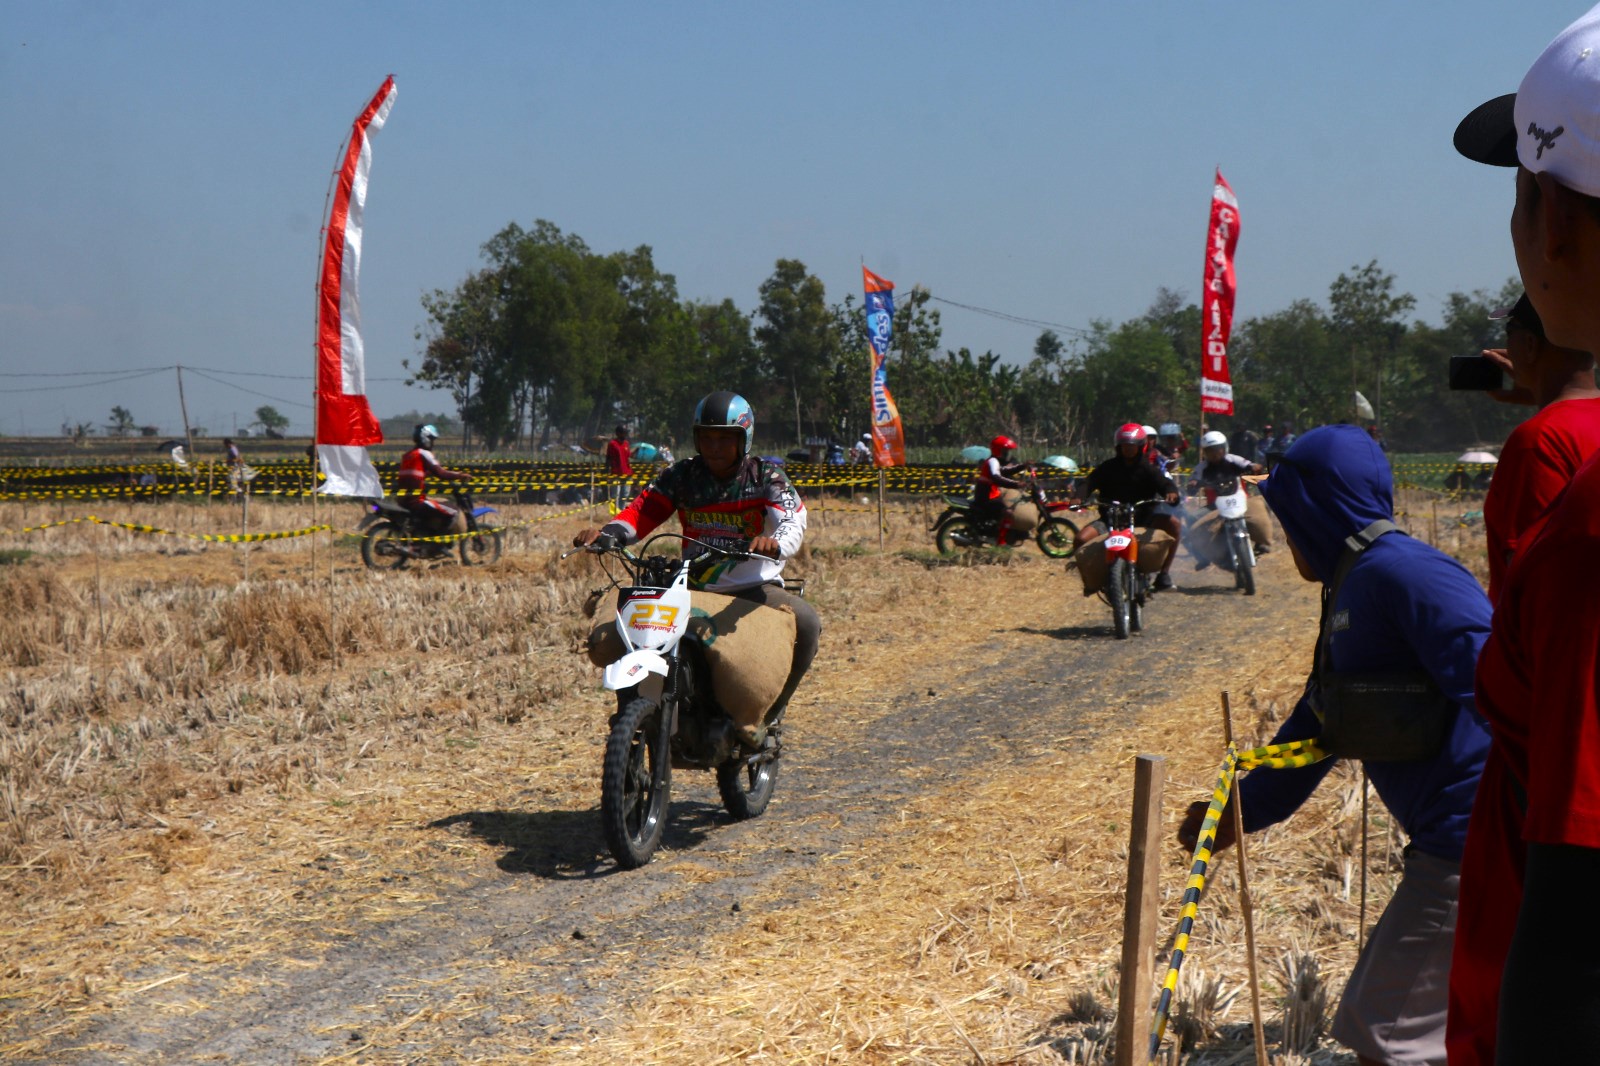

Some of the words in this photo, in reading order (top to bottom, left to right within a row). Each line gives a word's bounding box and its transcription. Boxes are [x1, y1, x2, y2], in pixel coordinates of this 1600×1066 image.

[1225, 498, 1237, 507] 99
[1110, 537, 1124, 545] 98
[628, 604, 679, 628] 23
